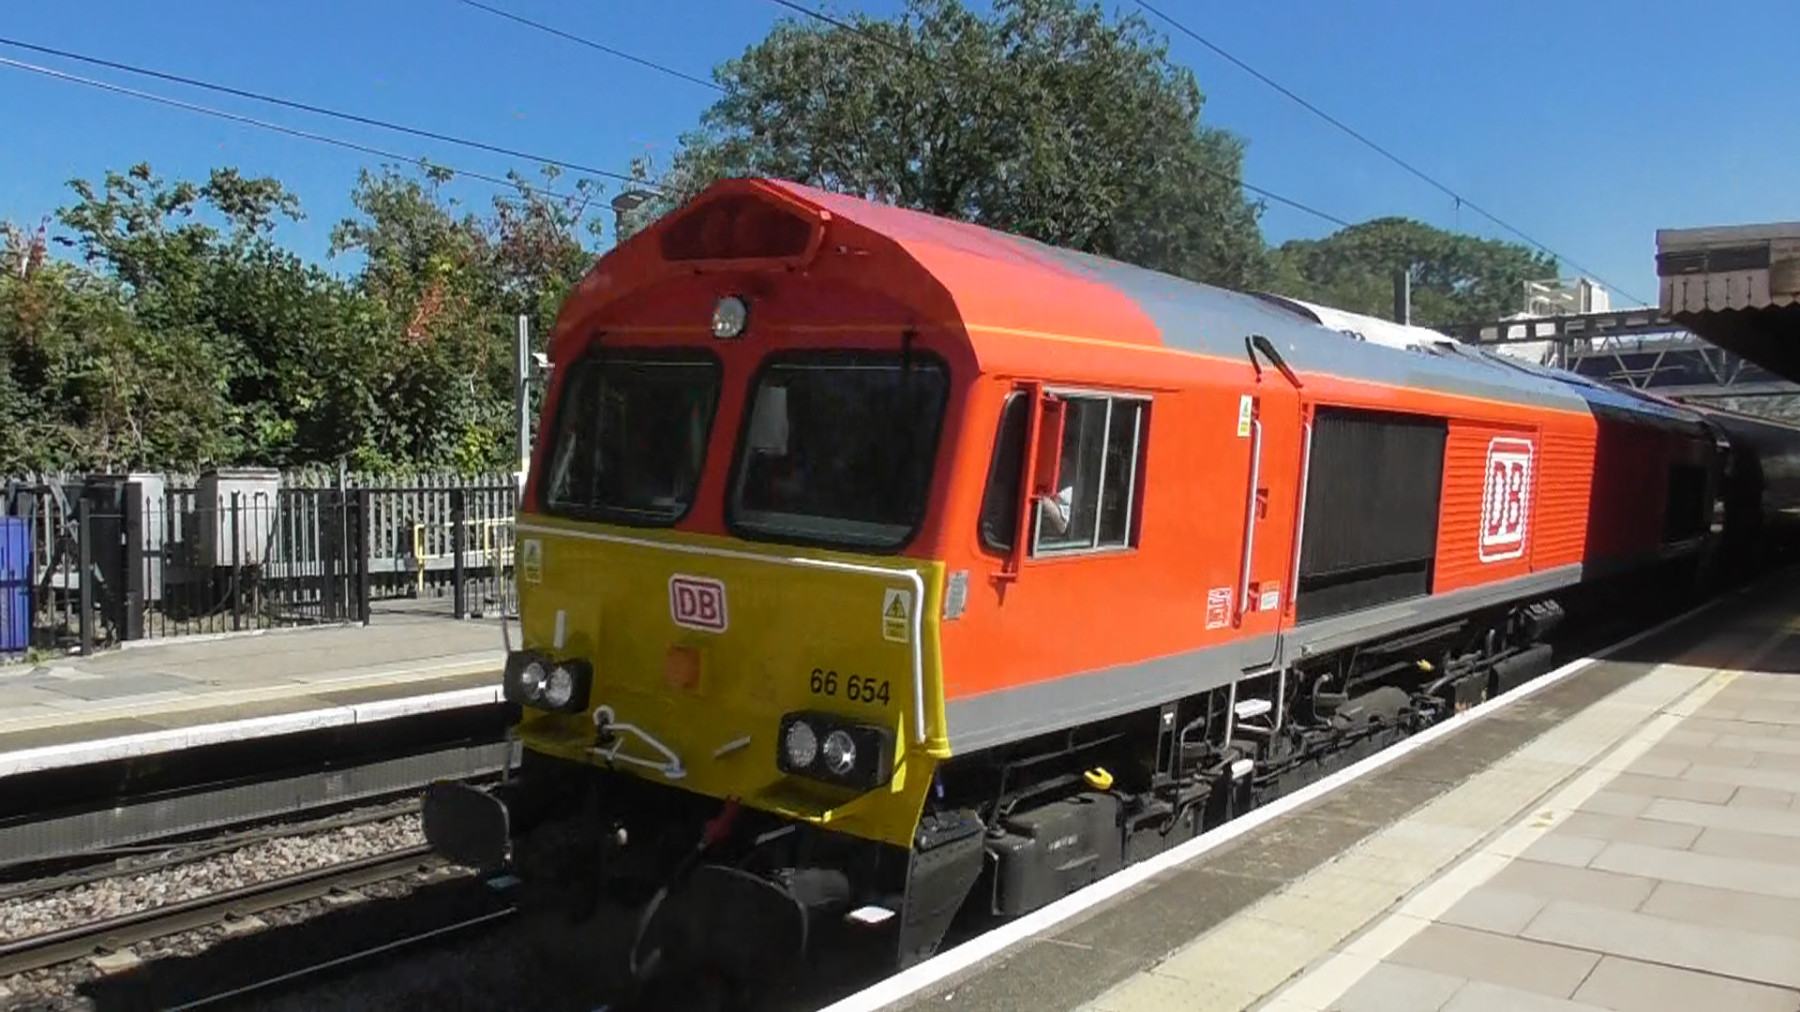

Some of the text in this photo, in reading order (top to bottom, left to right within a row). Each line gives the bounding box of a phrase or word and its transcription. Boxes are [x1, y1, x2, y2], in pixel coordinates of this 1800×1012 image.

[1488, 460, 1523, 536] DB
[678, 587, 717, 621] DB
[810, 668, 890, 707] 66 654
